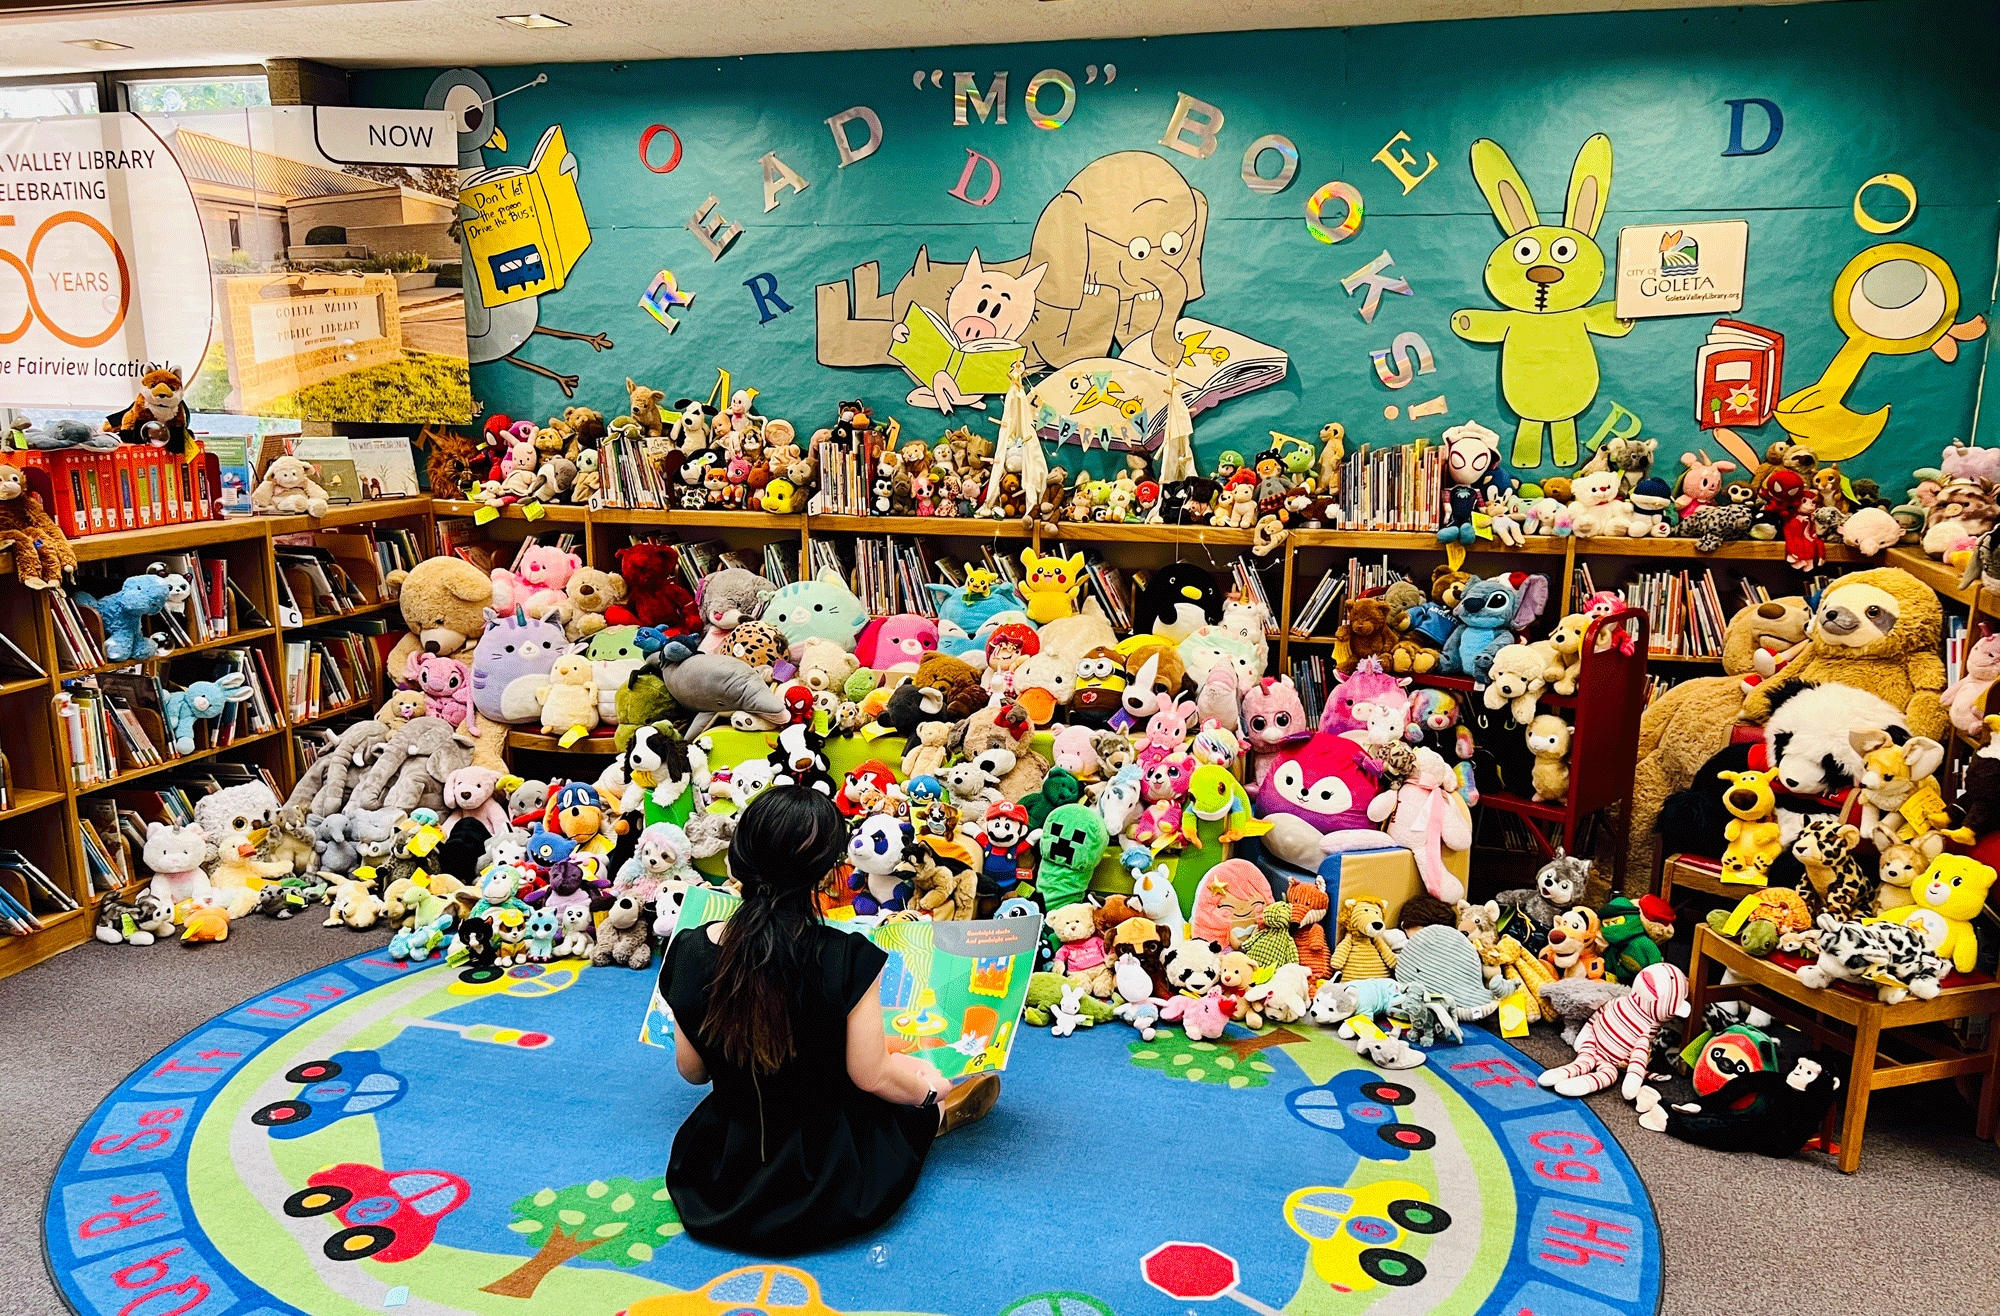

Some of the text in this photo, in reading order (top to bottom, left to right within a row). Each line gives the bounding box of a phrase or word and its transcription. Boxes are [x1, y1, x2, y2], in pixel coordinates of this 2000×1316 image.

[368, 125, 434, 148] NOW
[1720, 97, 1784, 157] D
[7, 152, 72, 172] VALLEY
[78, 150, 155, 170] LIBRARY
[639, 124, 682, 174] O
[1371, 129, 1439, 196] E
[948, 147, 1002, 207] D
[474, 178, 524, 209] Don't let
[1853, 173, 1918, 234] O
[469, 225, 494, 239] Drive
[494, 219, 507, 228] the
[480, 210, 495, 223] the
[50, 272, 109, 292] YEARS
[1626, 268, 1645, 277] CITY
[1640, 276, 1715, 297] GOLETA
[742, 272, 794, 326] R
[1665, 292, 1740, 302] GoletaValleyLibrary.org
[17, 357, 89, 376] Fairview
[591, 495, 598, 510] D
[289, 612, 298, 624] C
[915, 781, 927, 793] A
[153, 1048, 243, 1077] Tt
[1449, 1058, 1537, 1088] Ff
[89, 1107, 184, 1155] Ss
[1528, 1129, 1605, 1184] Gg
[78, 1189, 166, 1240] Rr
[1539, 1210, 1633, 1266] Hh
